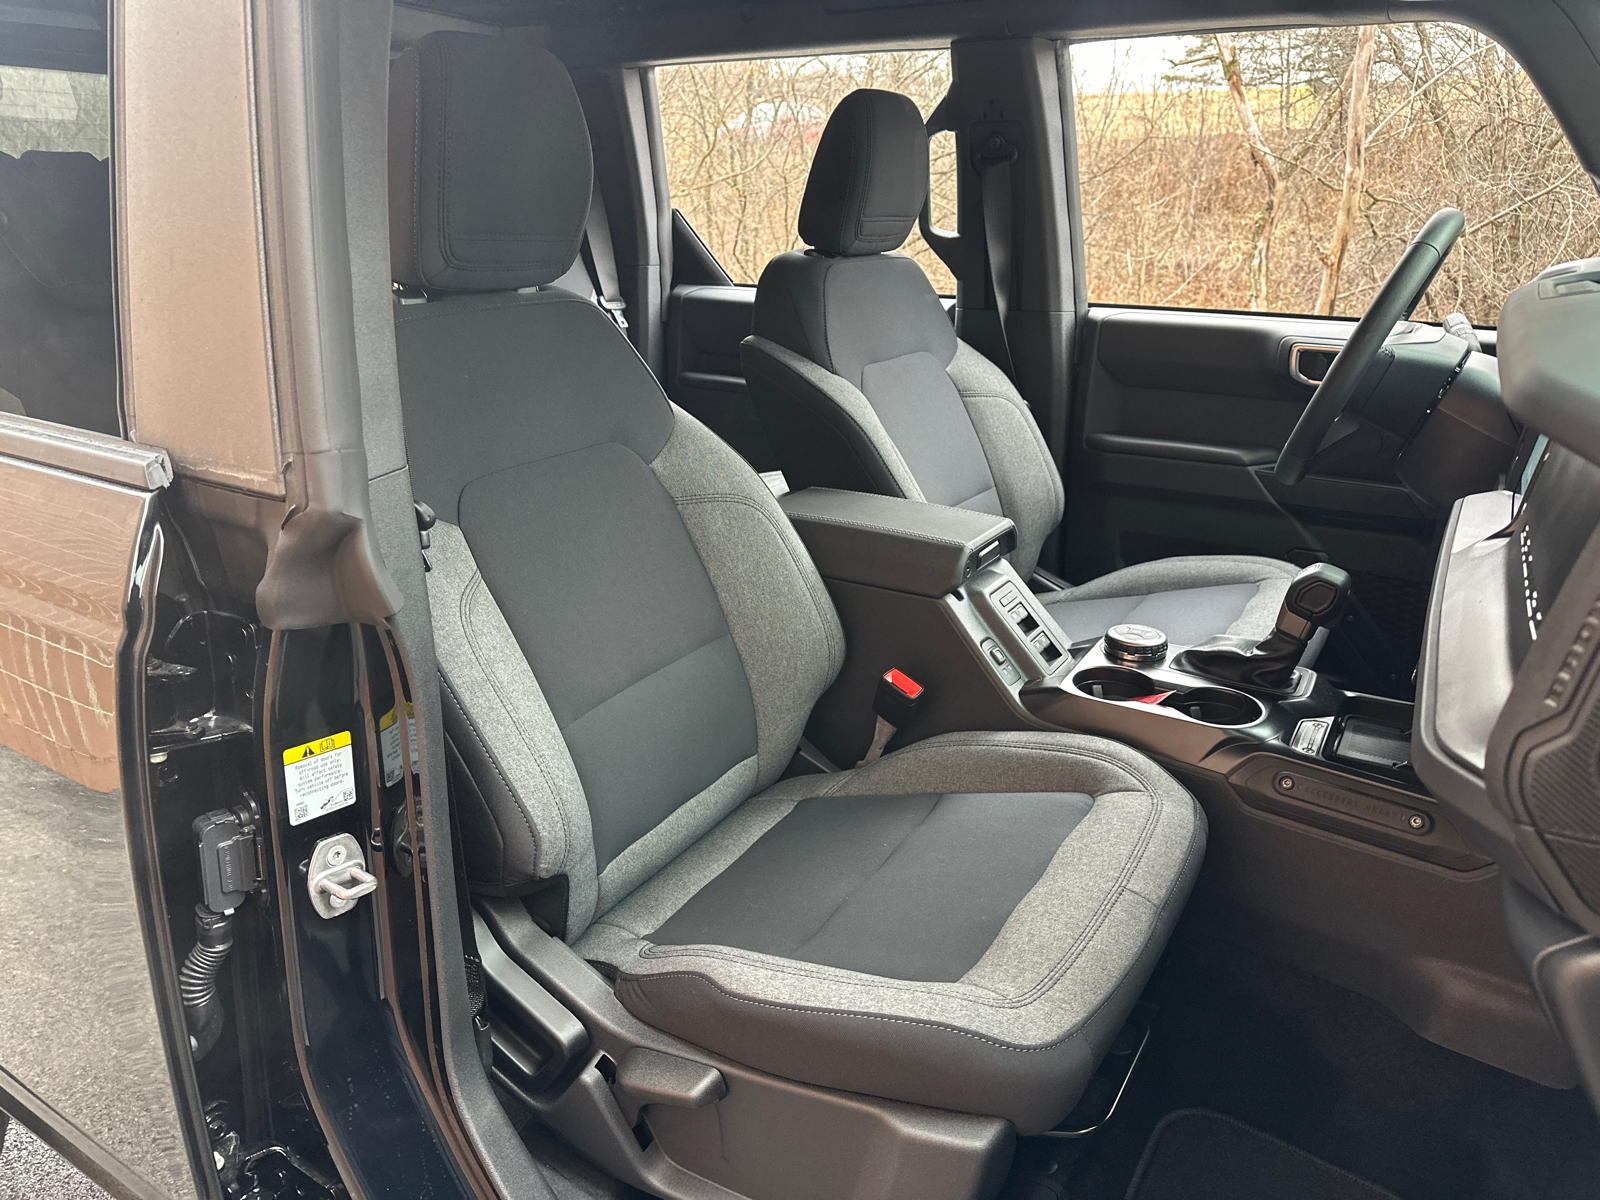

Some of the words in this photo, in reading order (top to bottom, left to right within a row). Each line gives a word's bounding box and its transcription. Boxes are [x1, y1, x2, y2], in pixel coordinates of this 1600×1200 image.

[295, 761, 312, 770] Removal
[299, 764, 318, 775] off-road
[307, 781, 324, 789] vehicle
[334, 772, 348, 780] before
